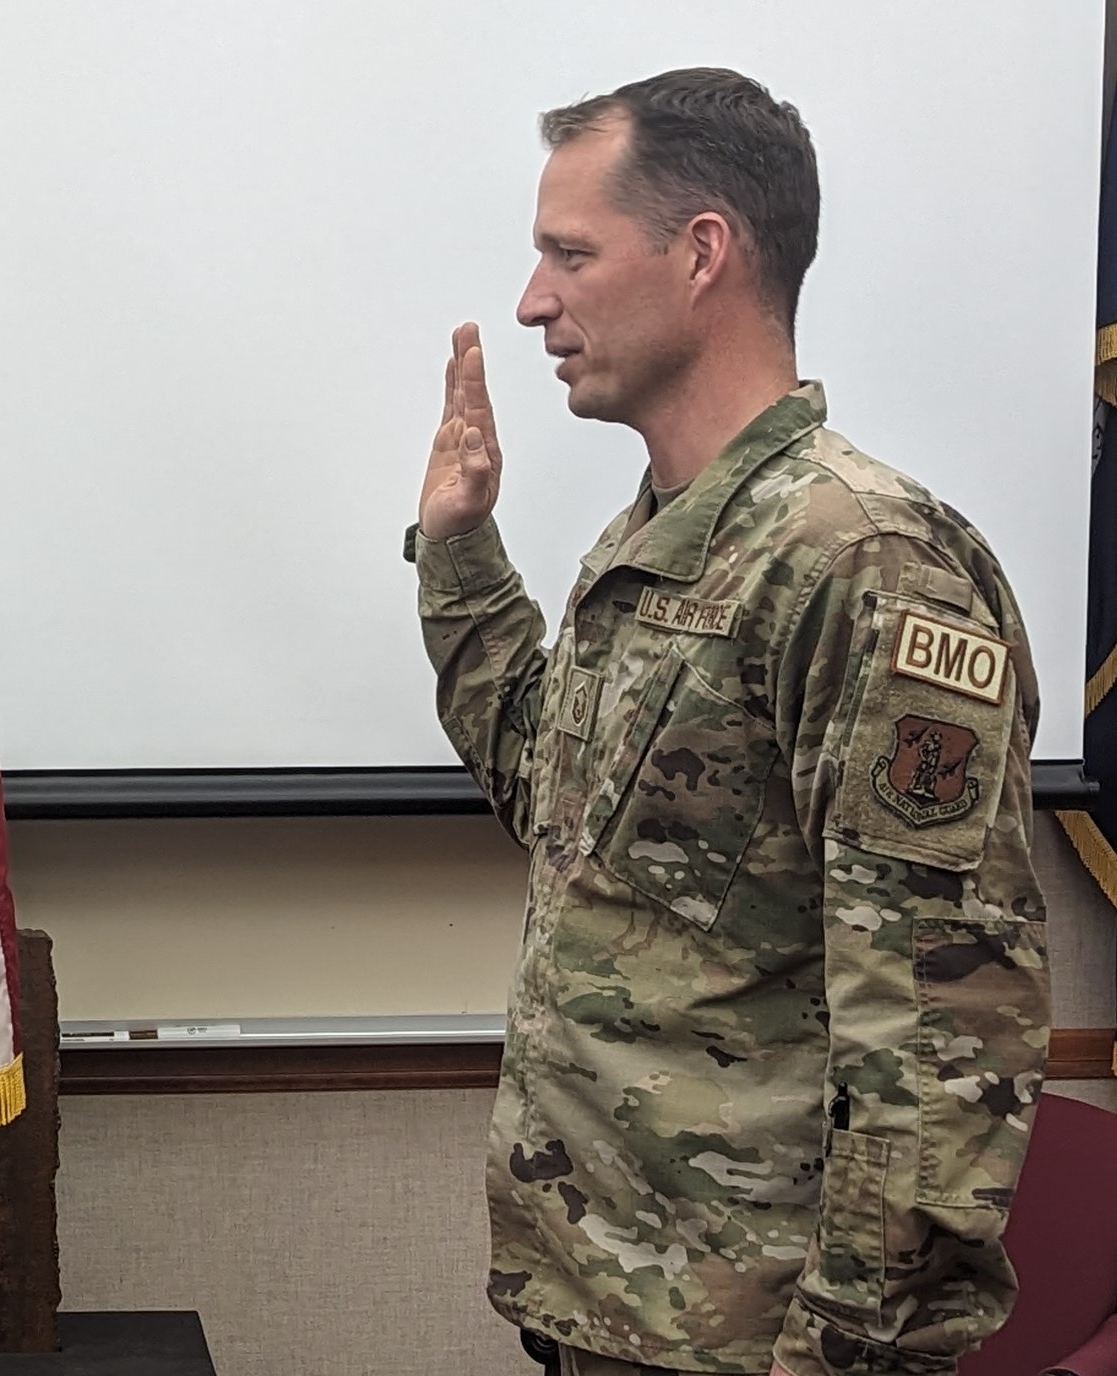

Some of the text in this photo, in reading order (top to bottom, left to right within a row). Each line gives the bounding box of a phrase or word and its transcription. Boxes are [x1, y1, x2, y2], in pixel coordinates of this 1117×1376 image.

[640, 589, 670, 622] U.S.
[672, 599, 698, 627] AIR
[905, 623, 996, 689] BMO
